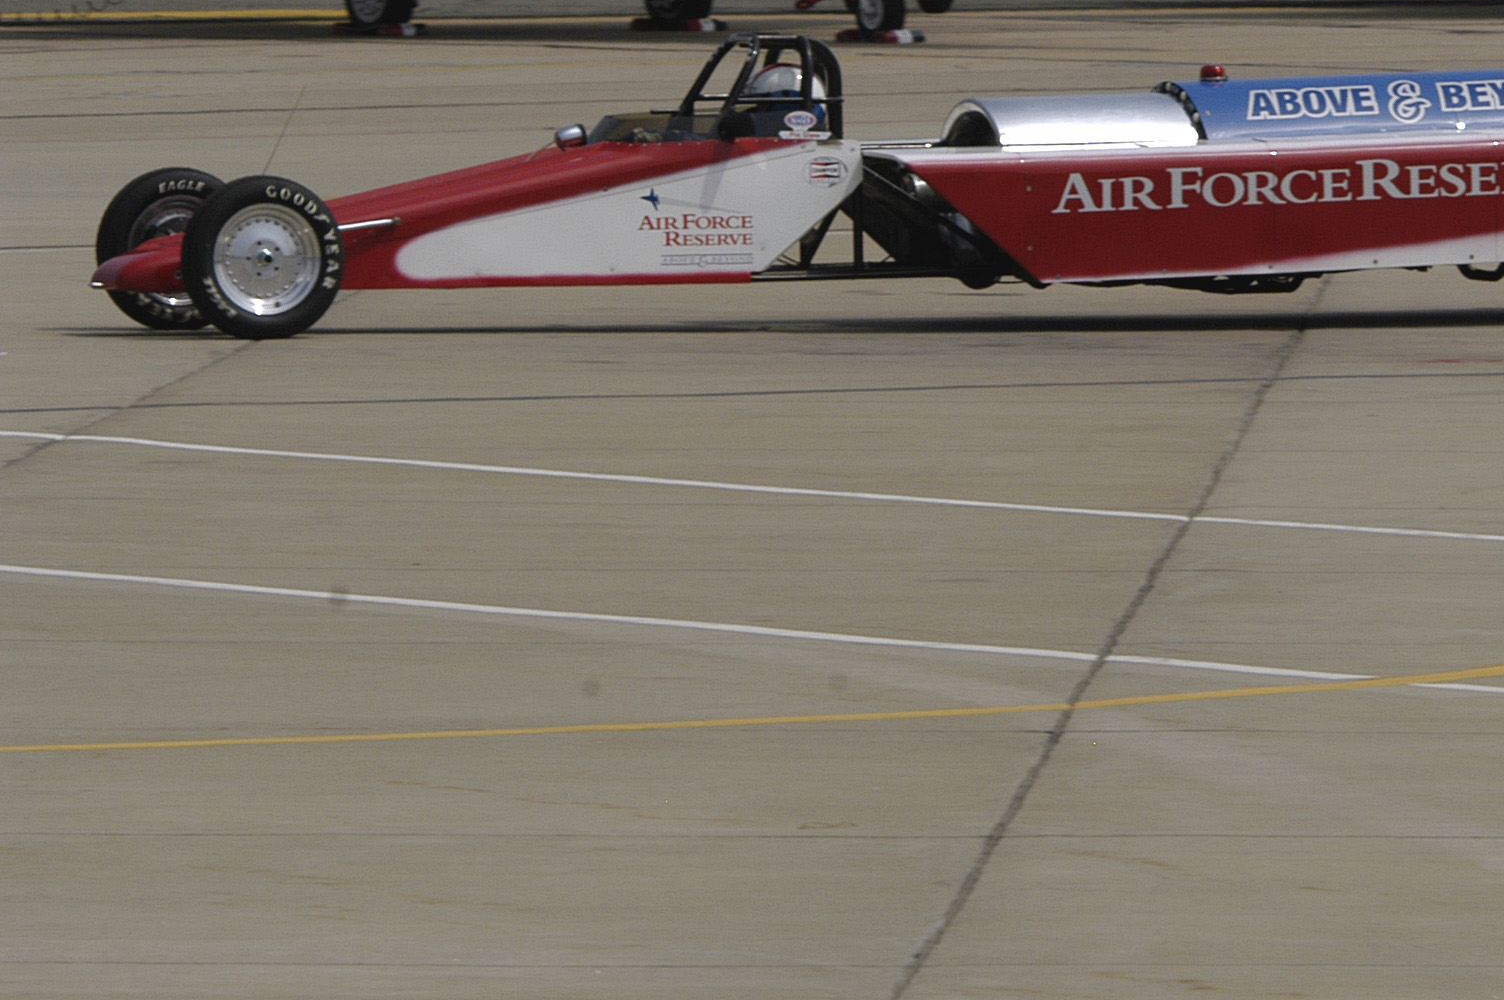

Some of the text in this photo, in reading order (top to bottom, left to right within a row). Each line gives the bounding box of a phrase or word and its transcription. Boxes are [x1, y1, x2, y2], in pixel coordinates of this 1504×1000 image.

[1247, 85, 1379, 120] ABOVE
[1388, 80, 1431, 124] &
[158, 179, 206, 194] EAGLE
[1051, 172, 1163, 214] AIR
[1157, 166, 1353, 209] FORCE
[638, 213, 754, 230] AIR FORCE
[265, 184, 340, 290] GOODYEAR
[664, 231, 754, 247] RESERVE
